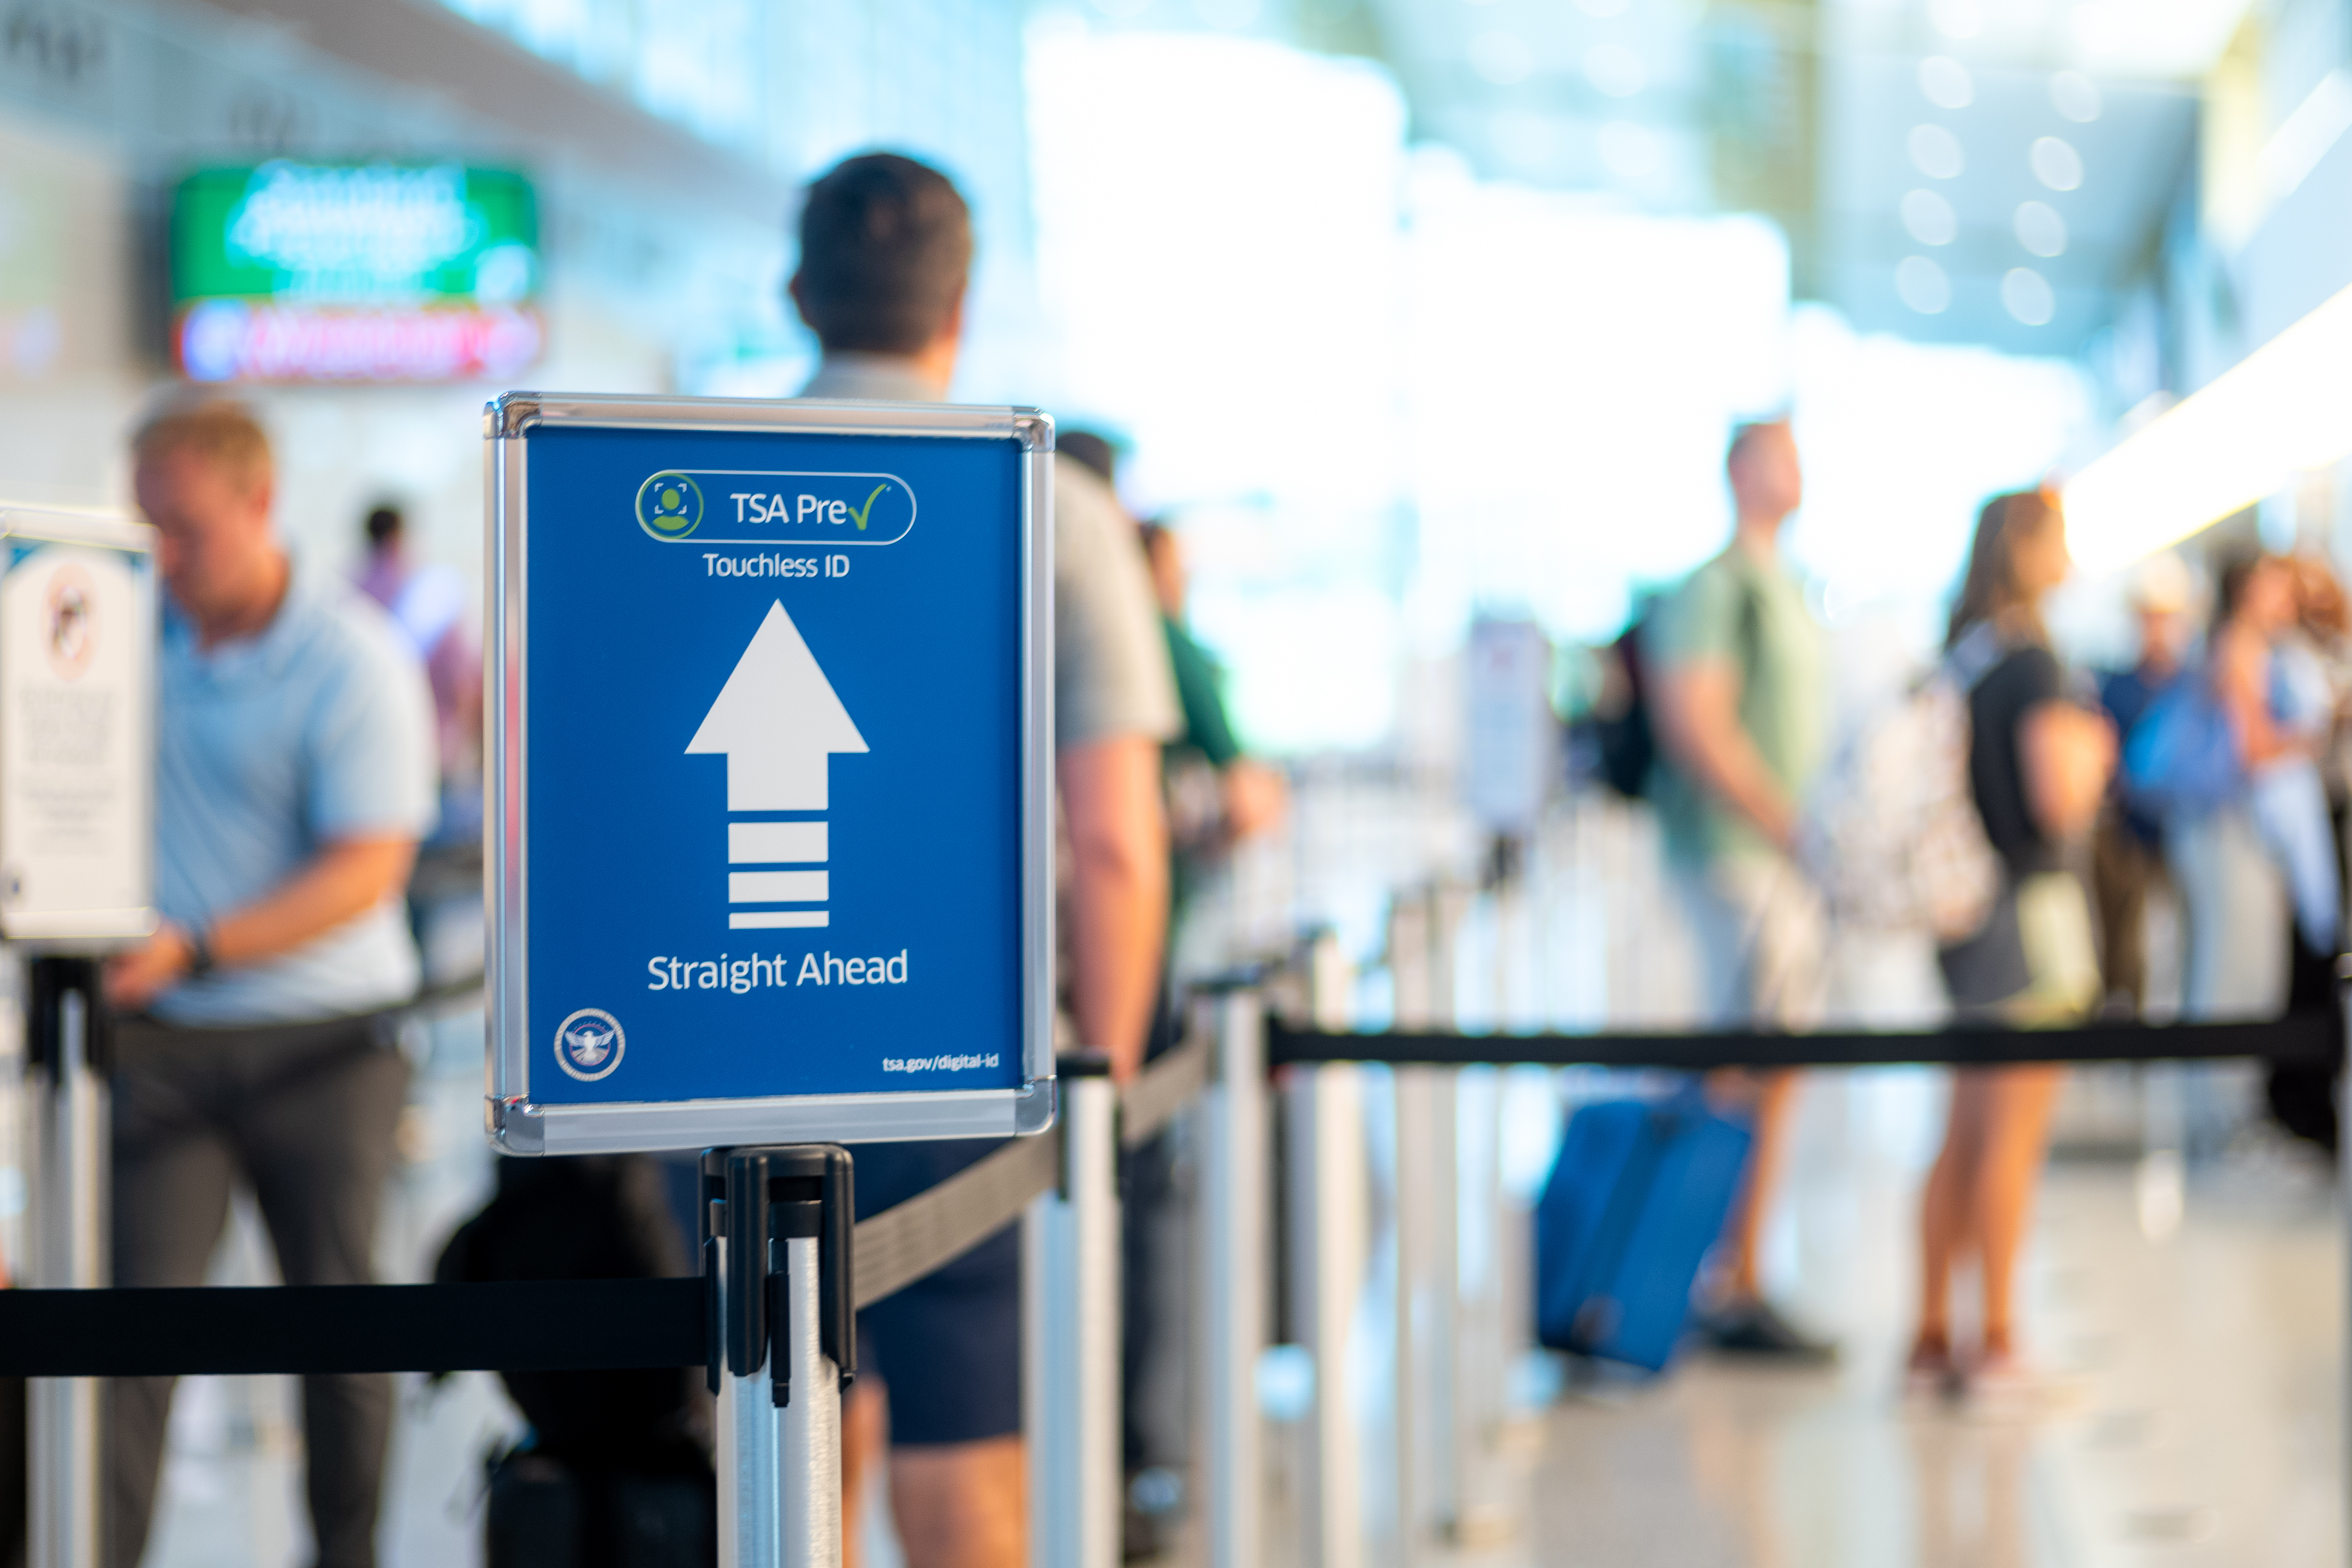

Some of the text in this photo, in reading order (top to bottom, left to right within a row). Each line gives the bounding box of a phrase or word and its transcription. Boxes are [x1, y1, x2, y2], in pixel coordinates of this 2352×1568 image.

[730, 494, 847, 524] TSA Pre
[703, 553, 850, 578] Touchless ID
[648, 949, 908, 994] Straight Ahead
[883, 1053, 999, 1074] tsa.gov/digital-id
